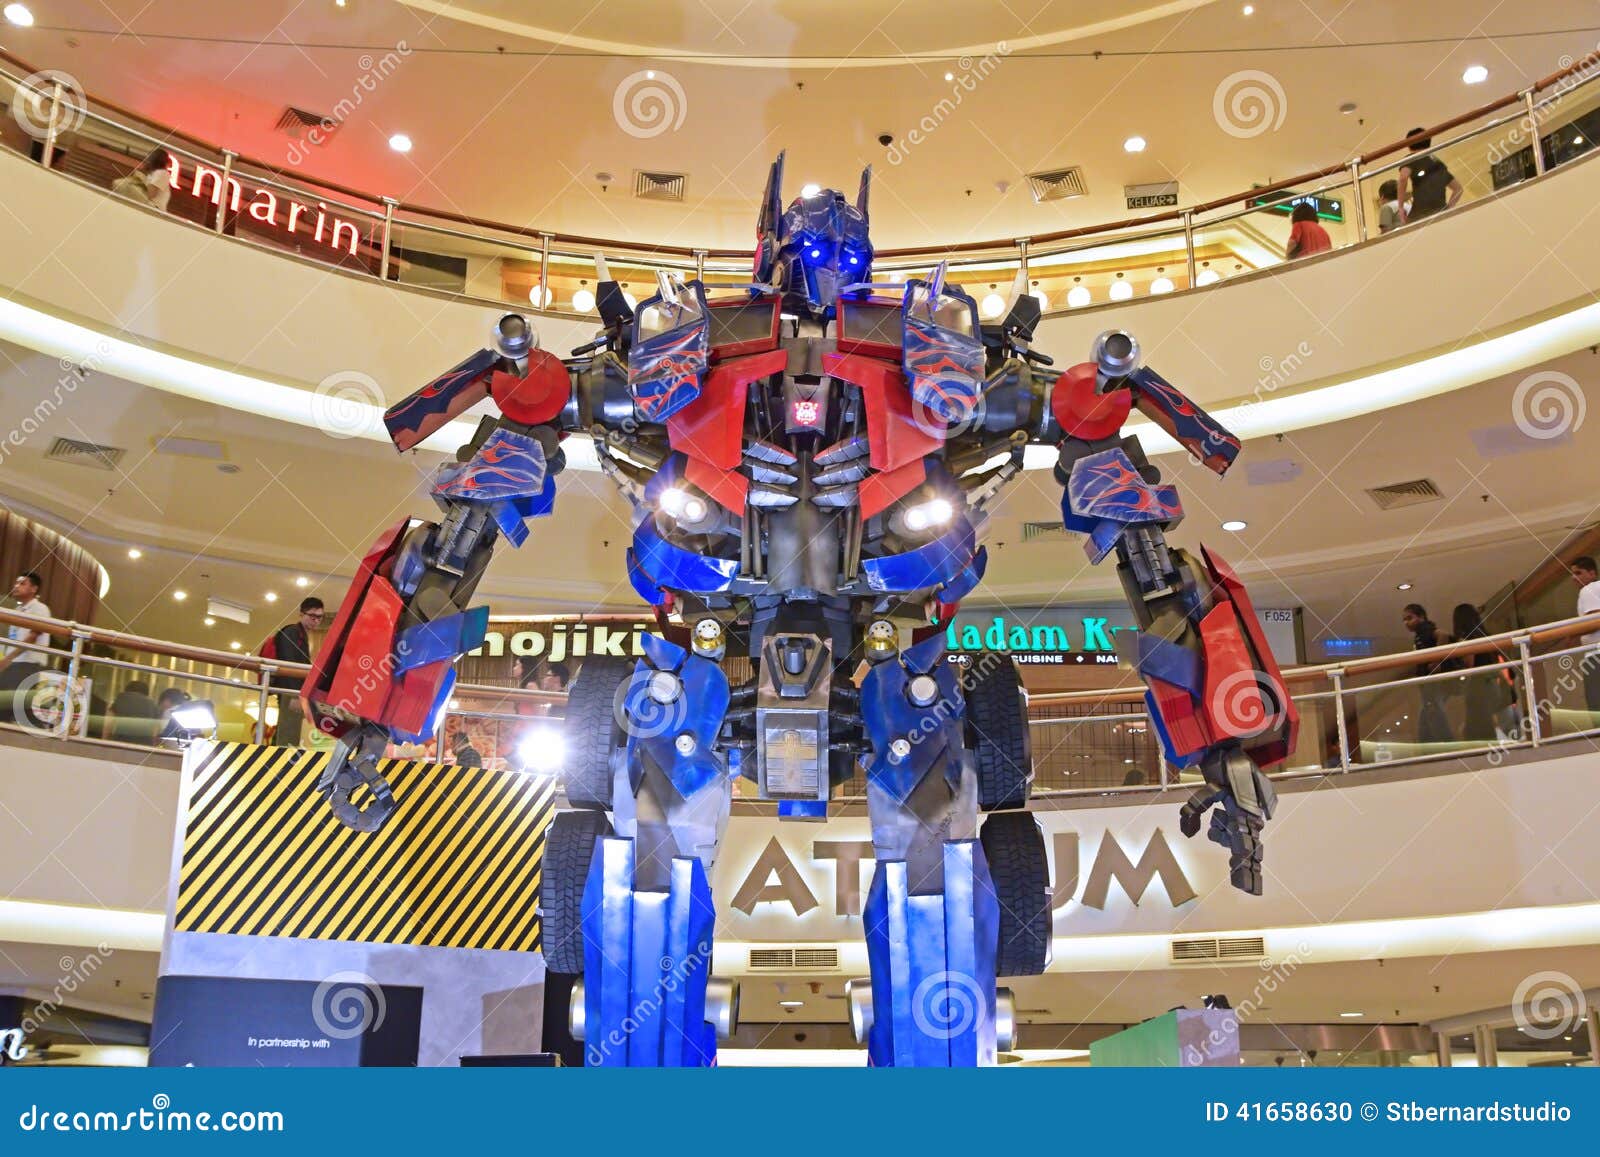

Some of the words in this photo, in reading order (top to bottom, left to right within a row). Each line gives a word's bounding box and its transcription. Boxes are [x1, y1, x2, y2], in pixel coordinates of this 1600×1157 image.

[248, 1037, 257, 1047] In
[258, 1038, 310, 1049] partnership
[312, 1039, 330, 1048] with
